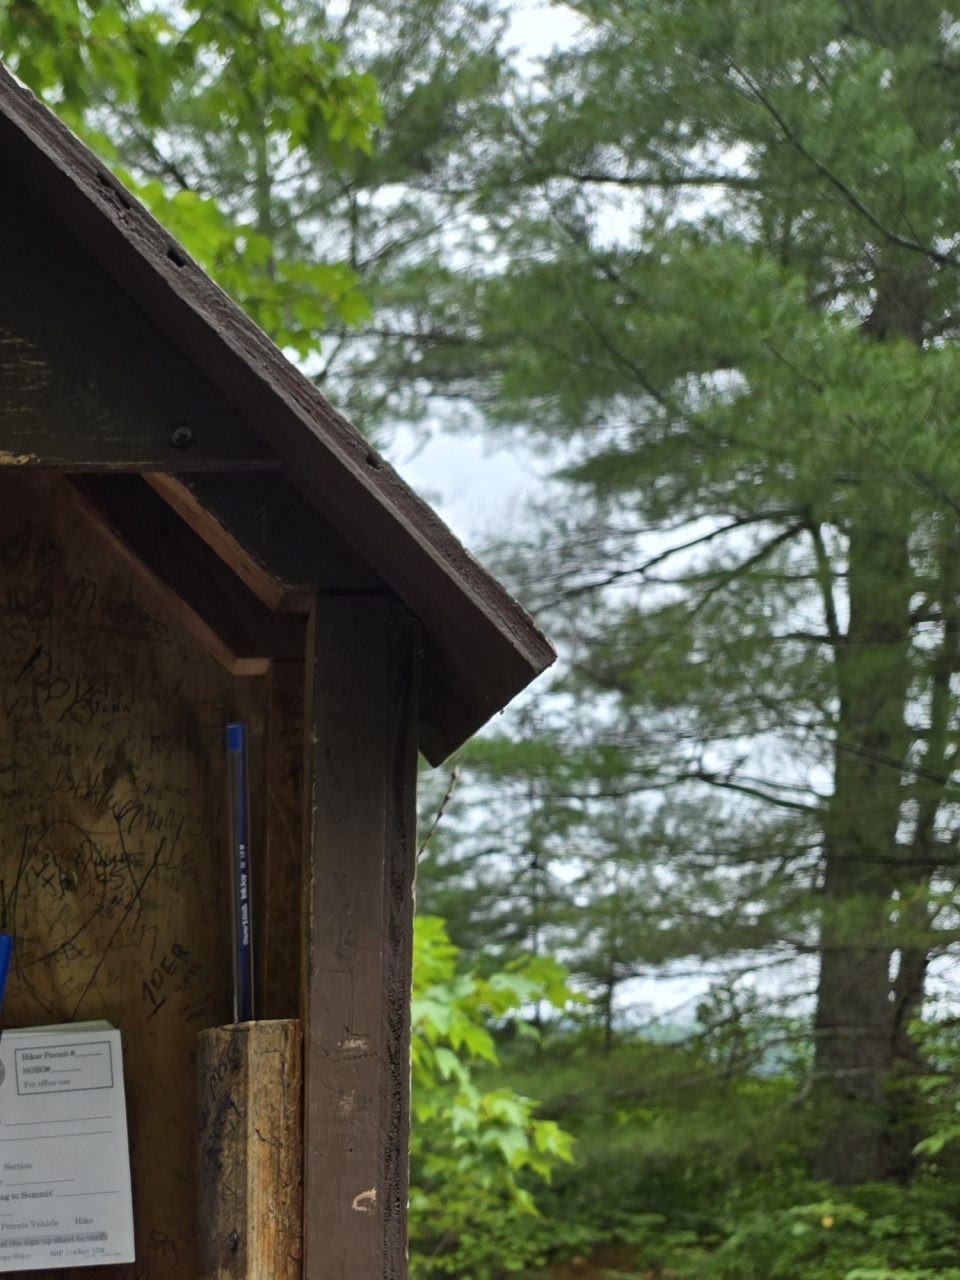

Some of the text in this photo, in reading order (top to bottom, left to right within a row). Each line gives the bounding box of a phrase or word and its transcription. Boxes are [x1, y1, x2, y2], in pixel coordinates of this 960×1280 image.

[22, 1052, 42, 1062] Hiker
[44, 1050, 70, 1060] Permit
[4, 1161, 33, 1171] Section
[12, 1192, 20, 1200] to
[1, 1220, 59, 1231] Private Vehicle
[74, 1217, 94, 1225] Hike
[10, 1238, 22, 1247] the
[54, 1234, 75, 1244] sheet
[76, 1234, 84, 1242] to
[85, 1231, 108, 1242] verify
